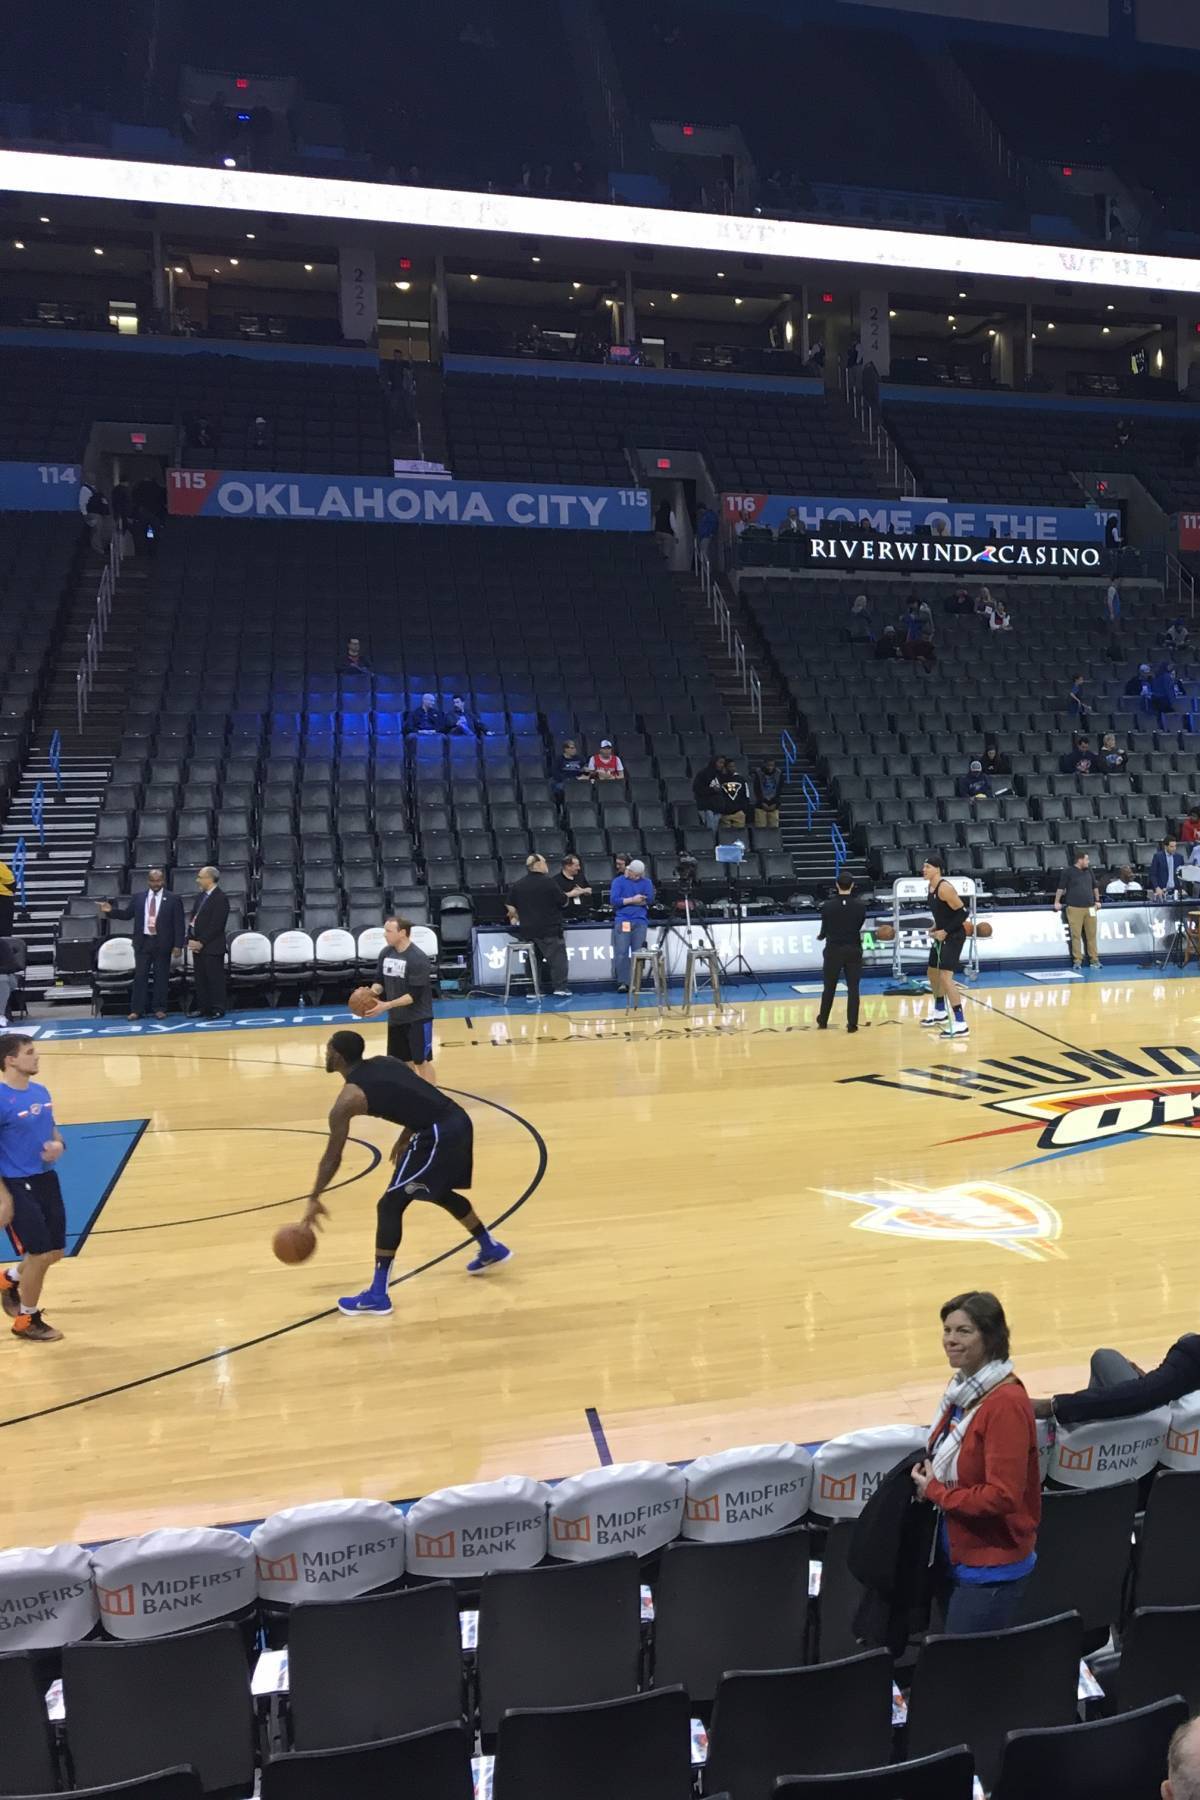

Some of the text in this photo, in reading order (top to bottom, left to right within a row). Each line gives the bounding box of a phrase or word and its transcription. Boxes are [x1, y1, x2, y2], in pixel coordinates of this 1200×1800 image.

[353, 268, 365, 317] 222
[870, 307, 880, 352] 224
[38, 466, 76, 484] 114
[171, 471, 207, 489] 115
[217, 482, 608, 526] OKLAHOMA CITY
[618, 489, 648, 507] 115
[726, 497, 756, 512] 116
[798, 506, 1057, 541] HOME OF THE
[810, 538, 1098, 566] RIVERWIND CASINO
[758, 935, 814, 955] FREE
[40, 1012, 364, 1039] paycom
[1097, 1454, 1138, 1471] BANK
[726, 1477, 807, 1507] MIDFIRST
[597, 1498, 682, 1530] MIDFIRST
[727, 1503, 774, 1523] BANK
[462, 1515, 544, 1543] MIDFIRS
[597, 1524, 647, 1544] BANK
[303, 1537, 398, 1567] MIDFIRST
[463, 1538, 516, 1558] BANK
[142, 1567, 245, 1596] MIDFIRST
[304, 1562, 359, 1583] BANK
[143, 1593, 203, 1614] BANK
[0, 1607, 58, 1629] BANK
